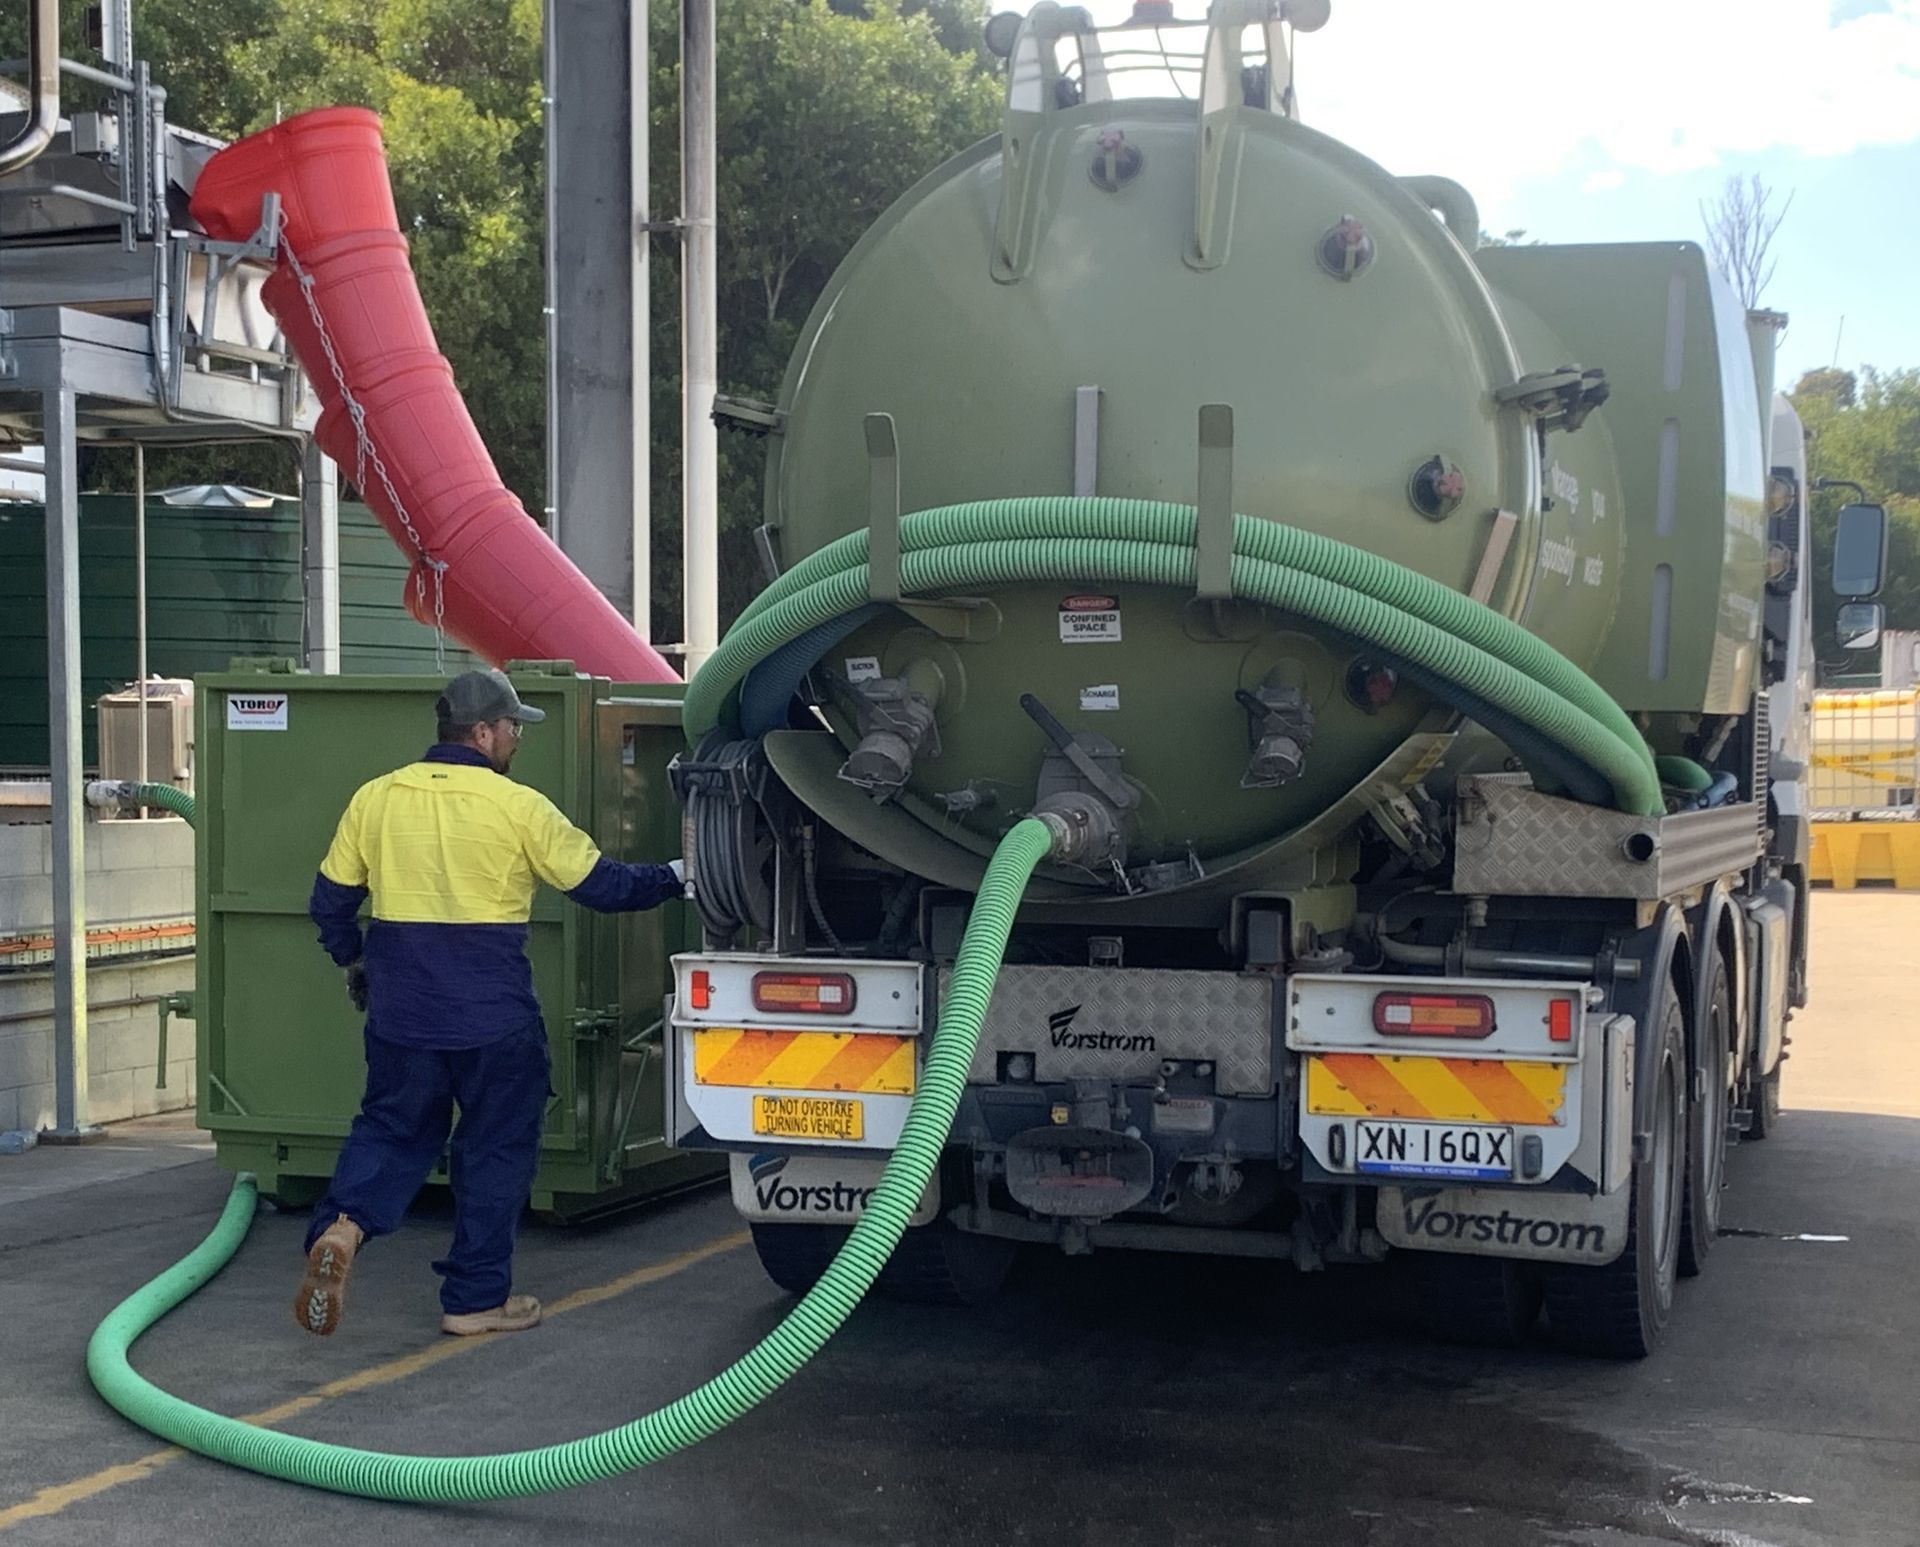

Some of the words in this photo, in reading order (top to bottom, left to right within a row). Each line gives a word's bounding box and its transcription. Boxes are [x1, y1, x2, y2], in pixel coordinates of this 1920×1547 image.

[1063, 614, 1117, 623] CONFINED
[1073, 623, 1107, 632] SPACE
[1051, 1027, 1156, 1051] Vorstrom
[762, 1098, 777, 1114] DO
[779, 1100, 798, 1115] NOT
[801, 1101, 854, 1118] OVERTAKE
[765, 1116, 808, 1133] TURNING
[810, 1117, 852, 1136] VEHICLE
[756, 1176, 878, 1212] Vorstr
[1402, 1199, 1604, 1251] Vorstrom
